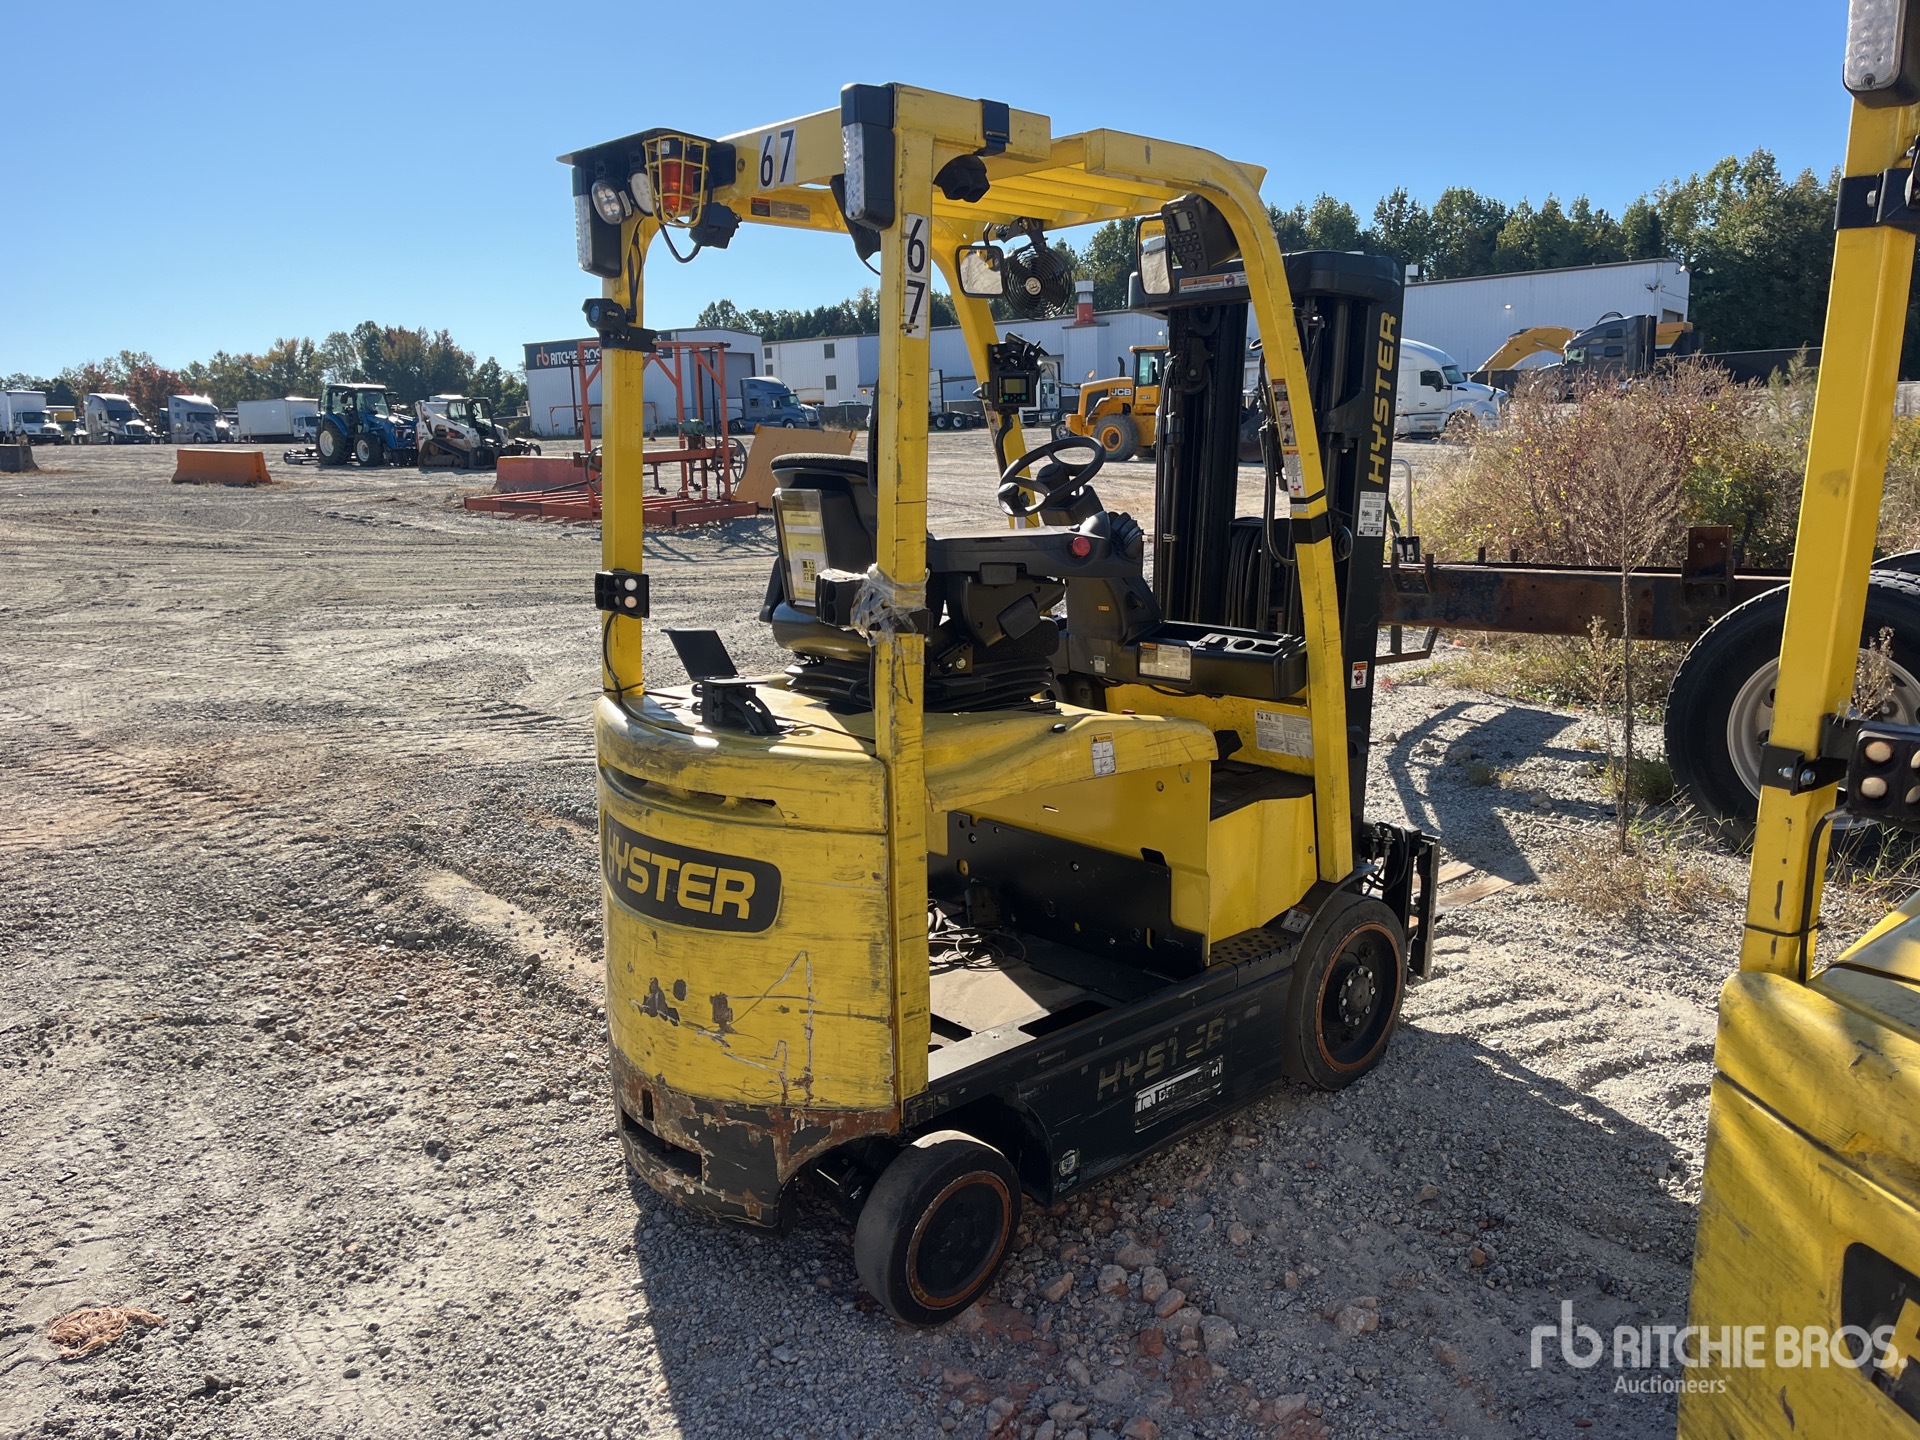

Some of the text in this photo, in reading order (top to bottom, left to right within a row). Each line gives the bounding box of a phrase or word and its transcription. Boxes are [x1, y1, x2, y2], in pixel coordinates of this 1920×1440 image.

[761, 129, 795, 187] 67
[907, 218, 926, 334] 67
[1111, 388, 1132, 396] JCB
[1368, 311, 1397, 485] HYSTER
[607, 826, 756, 920] HYSTER
